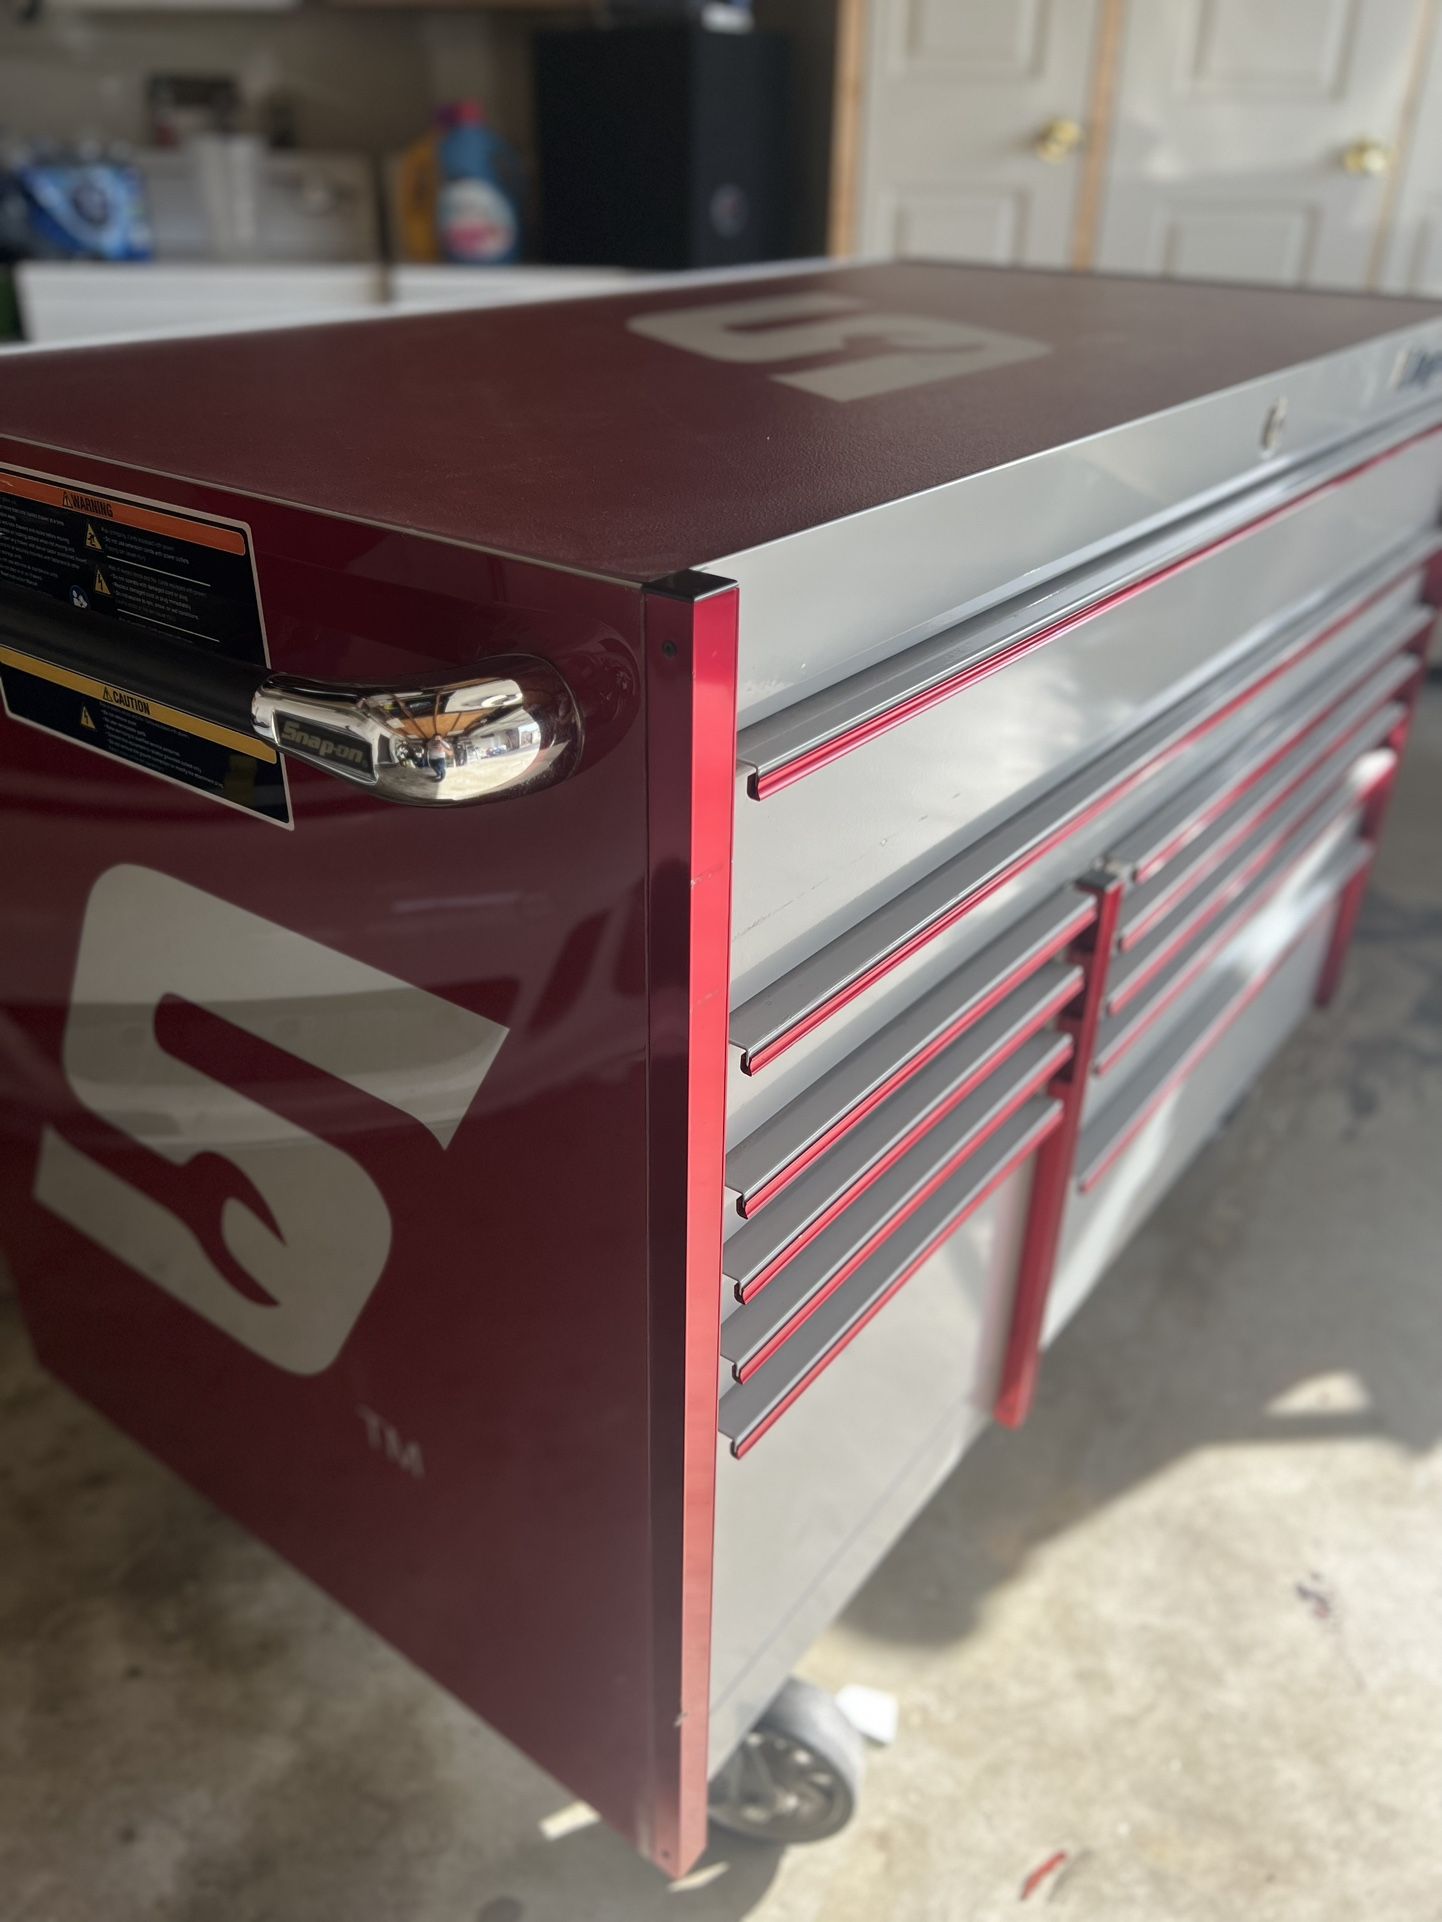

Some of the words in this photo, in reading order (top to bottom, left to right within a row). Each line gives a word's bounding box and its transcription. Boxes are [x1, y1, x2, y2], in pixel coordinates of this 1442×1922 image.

[70, 493, 113, 518] WARNING
[112, 690, 151, 715] CAUTION
[281, 720, 364, 763] Snap-on
[355, 1403, 425, 1478] TM
